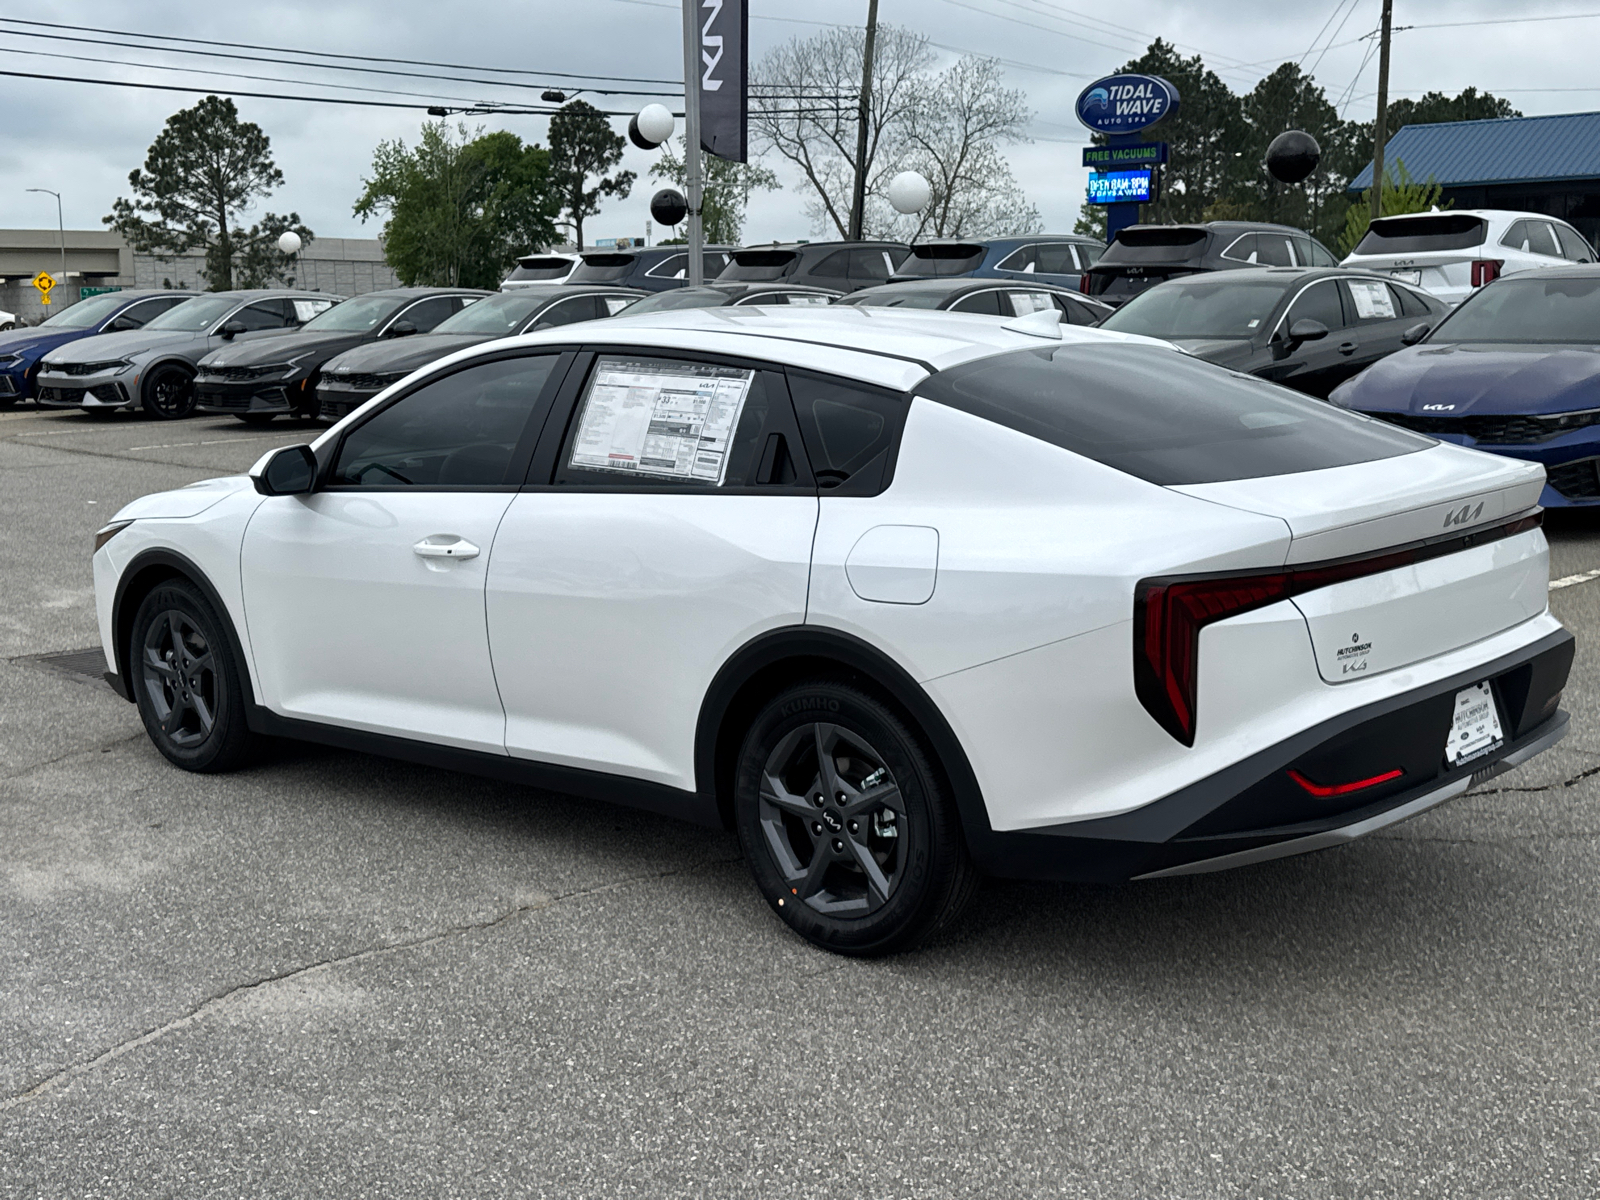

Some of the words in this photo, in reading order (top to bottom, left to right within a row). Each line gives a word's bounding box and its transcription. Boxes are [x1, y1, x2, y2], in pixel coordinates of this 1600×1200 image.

[1109, 83, 1153, 101] TIDAL
[1116, 98, 1163, 116] WAVE
[1128, 116, 1146, 124] SPA
[1086, 151, 1110, 162] FREE
[1112, 147, 1157, 160] VACUUMS
[1090, 179, 1110, 191] OPEN
[661, 396, 671, 404] 33
[1443, 501, 1485, 528] KIA
[1336, 642, 1372, 656] HUTCHINSON
[781, 697, 840, 718] KUMHO
[1454, 701, 1489, 724] HUTCHINSON
[823, 811, 841, 830] KIA
